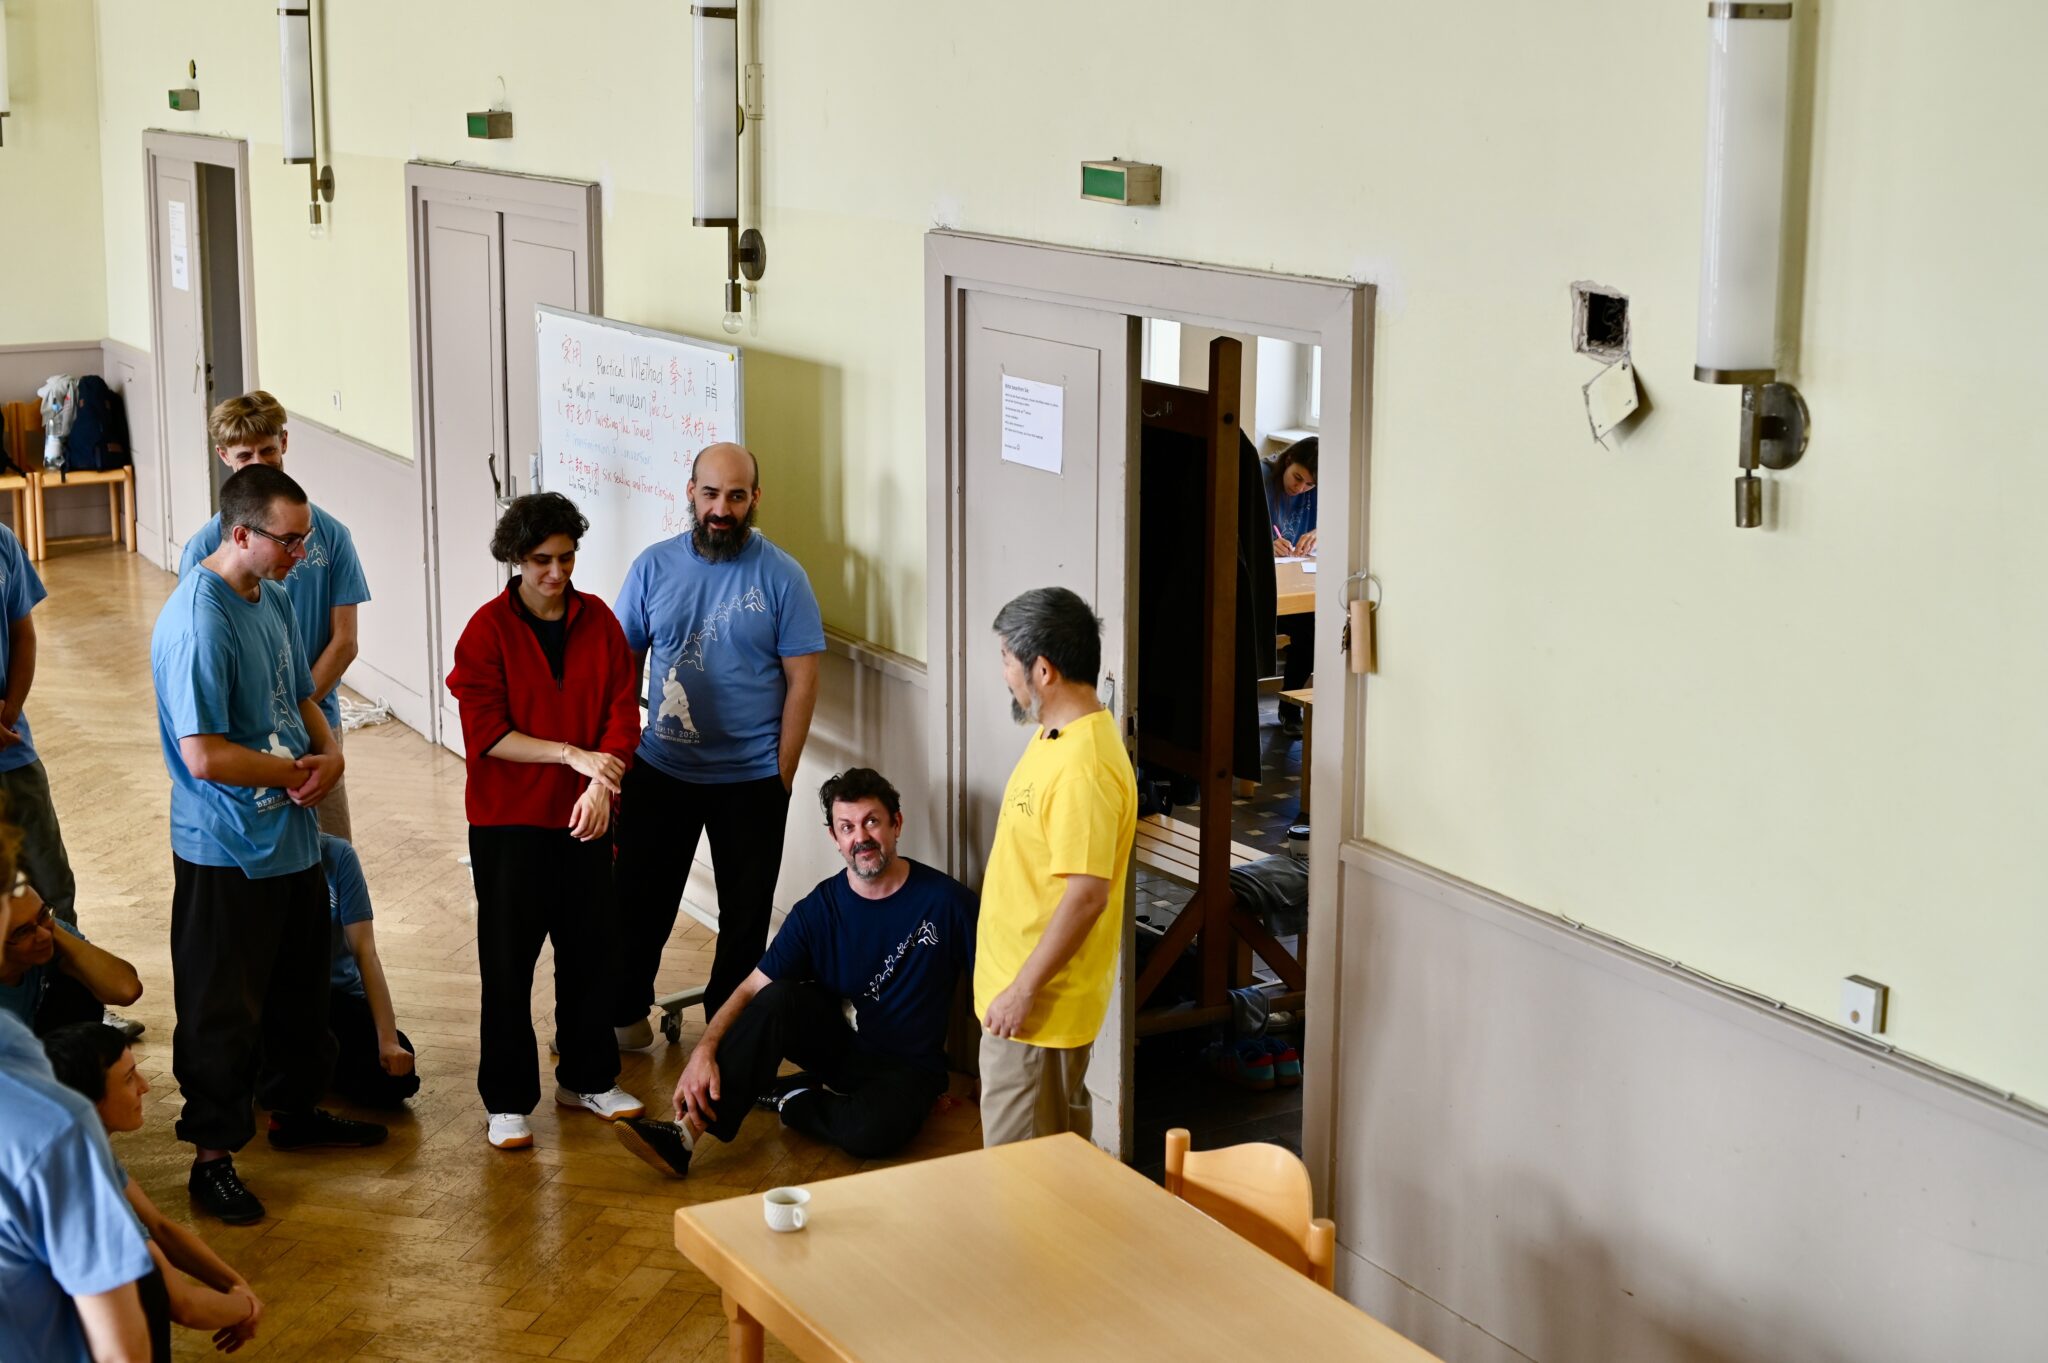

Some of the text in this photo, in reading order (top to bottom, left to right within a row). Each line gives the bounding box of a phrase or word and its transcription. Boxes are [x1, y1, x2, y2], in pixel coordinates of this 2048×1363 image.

[630, 355, 663, 385] Method
[670, 355, 696, 397] 拳法
[609, 386, 647, 416] Hunyuan
[631, 420, 653, 441] Towel
[678, 730, 700, 739] 2025
